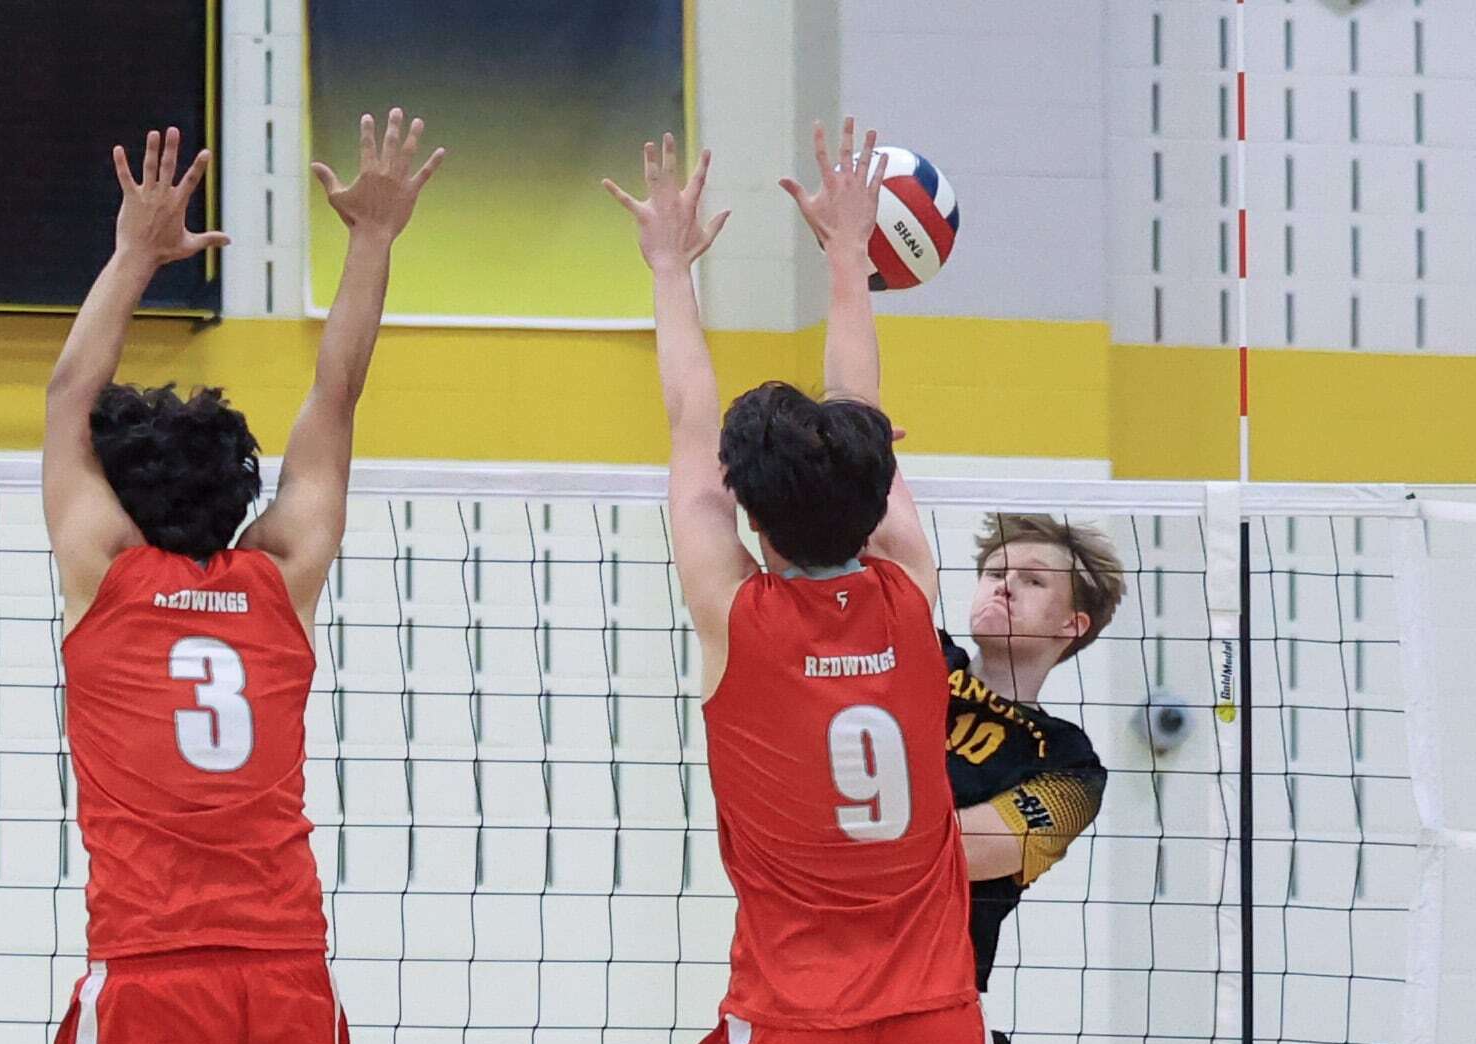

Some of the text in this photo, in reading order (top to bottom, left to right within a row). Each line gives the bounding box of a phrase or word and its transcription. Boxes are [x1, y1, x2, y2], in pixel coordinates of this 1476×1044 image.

[154, 589, 249, 613] REDWINGS
[168, 635, 255, 773] 3
[945, 712, 1006, 765] 10
[828, 704, 912, 842] 9
